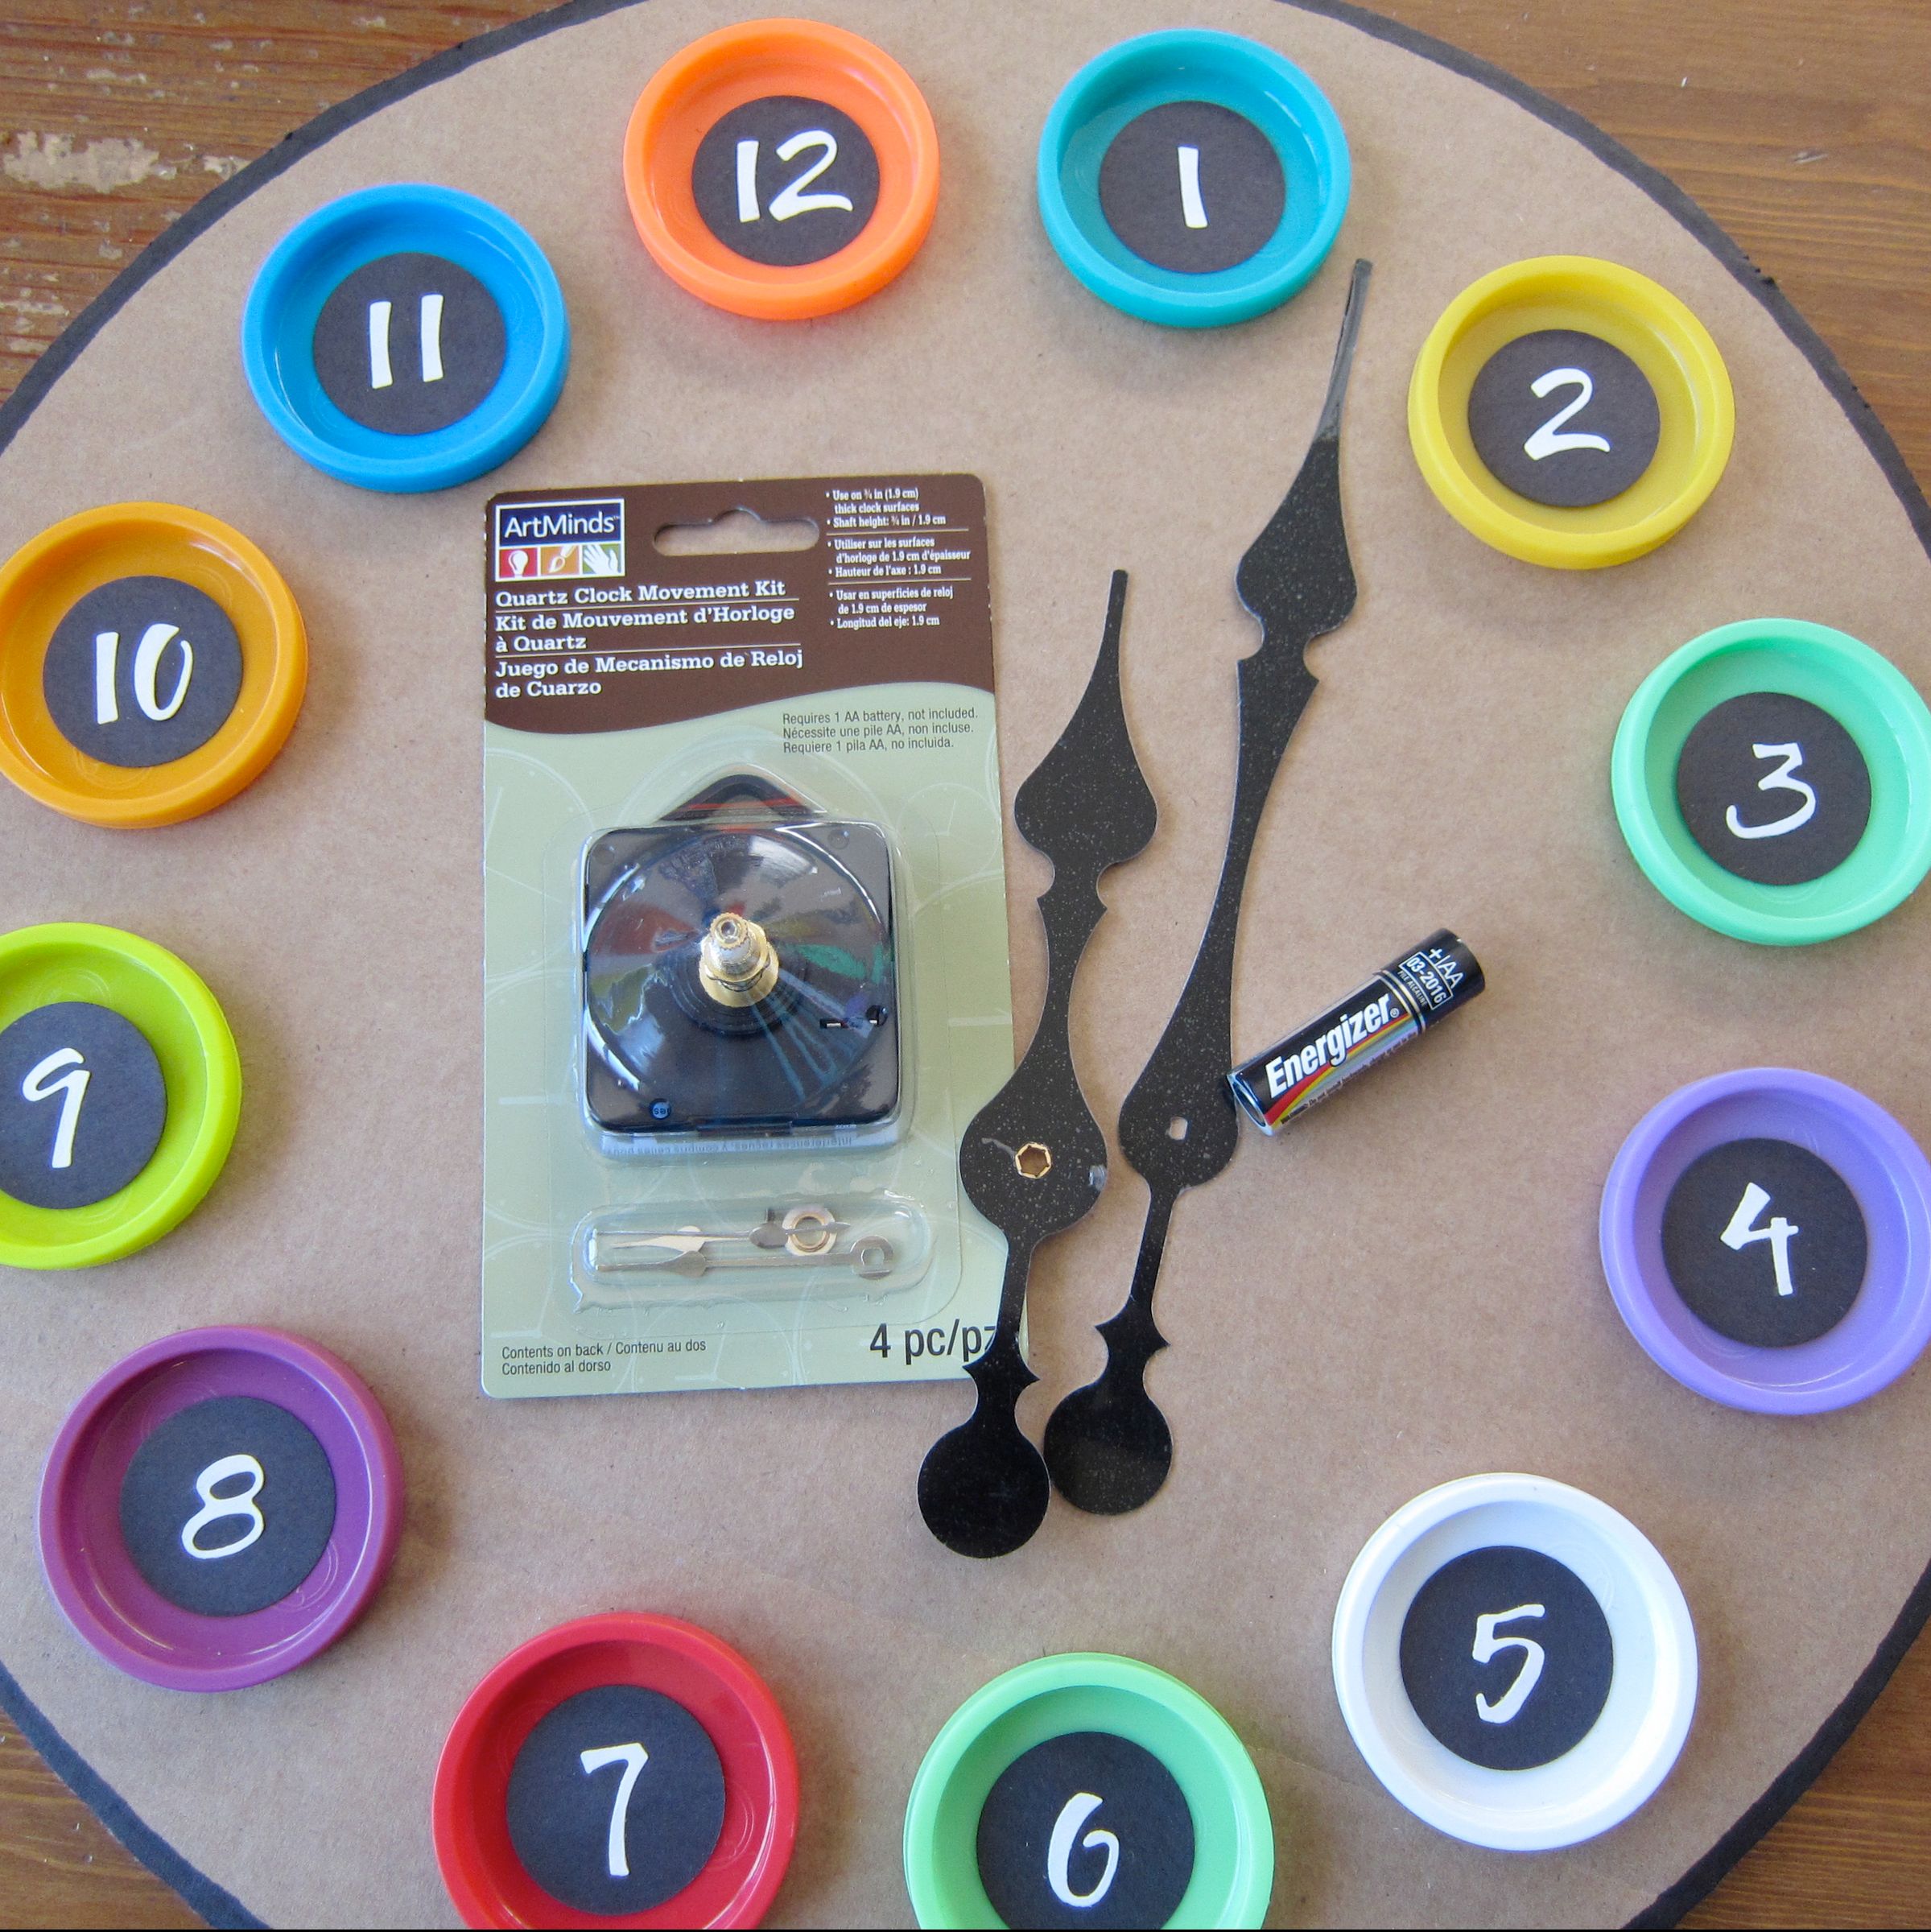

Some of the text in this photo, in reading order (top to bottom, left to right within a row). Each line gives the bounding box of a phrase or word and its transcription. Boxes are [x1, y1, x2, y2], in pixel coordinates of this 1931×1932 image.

[736, 130, 853, 222] 12
[1177, 146, 1207, 229] 1
[369, 294, 444, 389] 11
[1524, 367, 1610, 460] 2
[833, 490, 849, 501] Use
[851, 491, 862, 500] on
[874, 489, 882, 499] in
[885, 489, 901, 500] (1.9
[902, 487, 918, 500] cm)
[835, 502, 919, 514] thick clock surfaces
[505, 512, 614, 538] ArtMinds
[833, 517, 856, 528] Shaft
[859, 517, 889, 528] height:
[902, 516, 910, 526] in
[918, 515, 930, 525] 1.9
[932, 516, 946, 525] cm
[834, 537, 935, 550] Utiliser sur les surfaces
[836, 550, 971, 564] d'horloge de 1.9 cm d'épaisseur
[836, 567, 871, 578] Hauteur
[873, 566, 884, 576] de
[886, 565, 906, 576] l'axe
[914, 564, 926, 575] 1.9
[928, 566, 941, 574] cm
[496, 580, 786, 608] Quartz Clock Movement Kit
[836, 586, 954, 601] Usar en superficies de reloj
[496, 605, 794, 631] Kit de Mouvement d'Horloge
[838, 604, 848, 614] de
[851, 603, 864, 613] 1.9
[881, 603, 892, 613] de
[893, 603, 927, 614] espesor
[837, 616, 939, 630] Longitud del eje: 1.9 cm
[496, 635, 586, 653] à Quartz
[94, 623, 195, 724] 10
[495, 649, 803, 678] Juego de Mecanismo de Reloj
[496, 679, 601, 698] de Cuarzo
[783, 708, 978, 726] Requires 1 AA battery, not included.
[783, 723, 973, 739] Nécessite une pile AA, non incluse.
[784, 737, 953, 754] Requiere 1 pila AA, no incluida.
[1726, 741, 1817, 840] 3
[1406, 957, 1446, 1003] 03-2016
[22, 1047, 91, 1168] 9
[1721, 1183, 1798, 1295] 4
[502, 1346, 553, 1360] Contents
[557, 1348, 571, 1357] on
[576, 1344, 603, 1356] back
[616, 1341, 663, 1355] Contenu
[667, 1343, 681, 1352] au
[686, 1339, 706, 1351] dos
[870, 1323, 891, 1358] 4
[502, 1360, 611, 1375] Contenido al dorso
[181, 1454, 264, 1558] 8
[1472, 1604, 1545, 1724] 5
[580, 1742, 649, 1877] 7
[1048, 1793, 1120, 1908] 6
